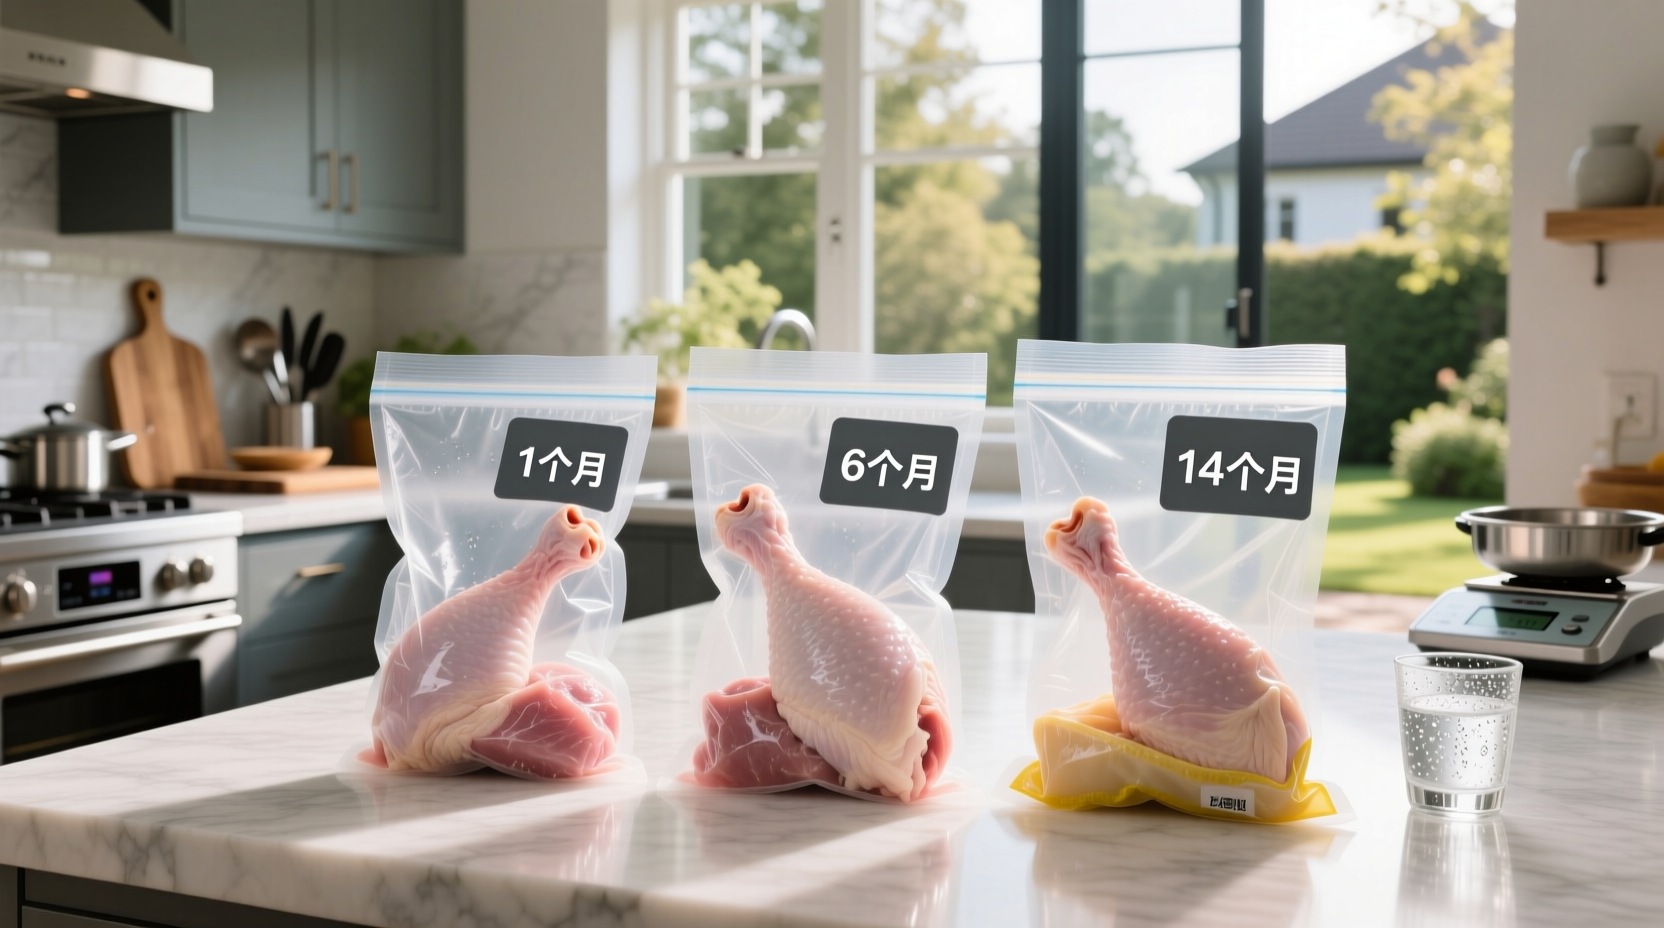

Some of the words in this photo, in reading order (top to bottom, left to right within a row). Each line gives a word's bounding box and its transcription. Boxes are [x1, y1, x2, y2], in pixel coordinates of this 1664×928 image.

[519, 446, 606, 488] 1个月
[840, 448, 938, 492] 6个月
[1178, 449, 1301, 495] 14个月
